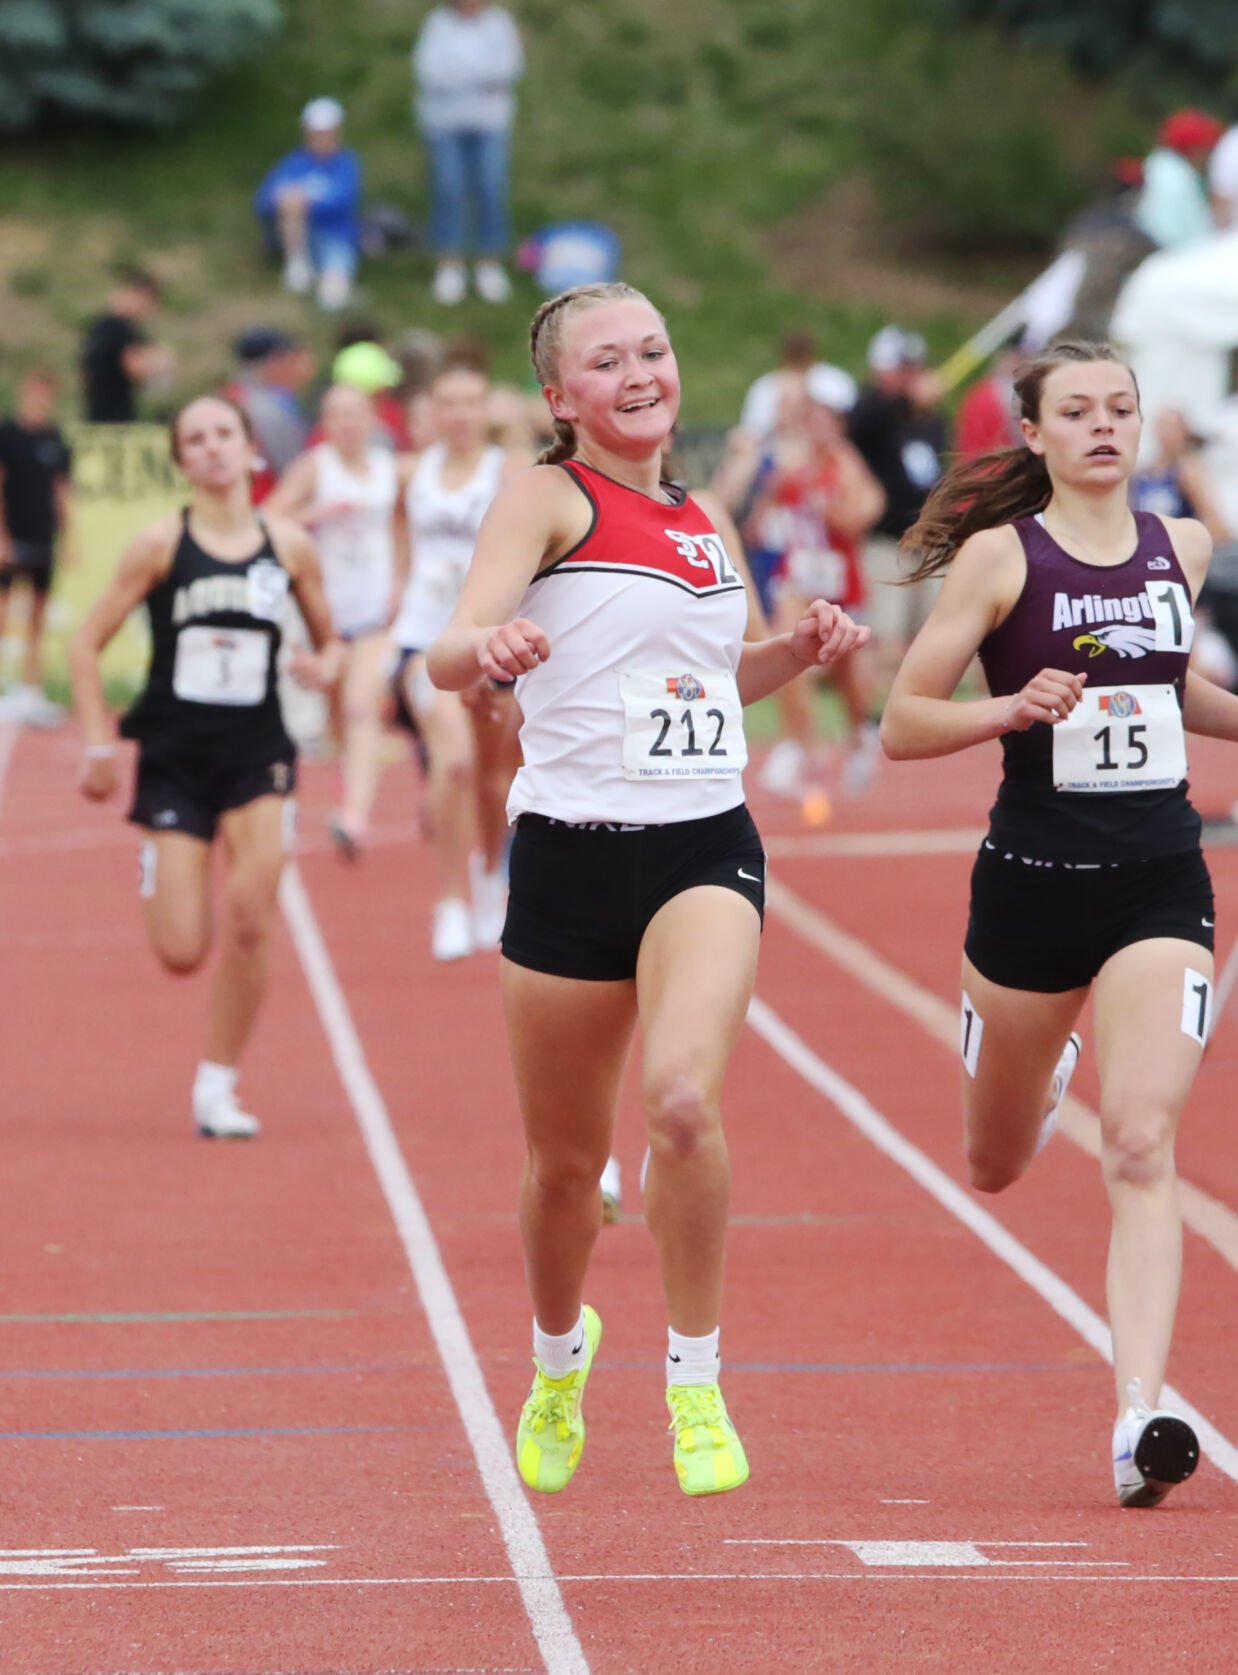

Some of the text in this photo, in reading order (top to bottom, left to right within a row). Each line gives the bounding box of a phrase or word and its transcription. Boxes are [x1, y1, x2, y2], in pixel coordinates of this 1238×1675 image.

[1156, 586, 1182, 647] 1
[648, 708, 728, 757] 212
[1093, 724, 1149, 771] 15
[638, 768, 662, 776] TRACK
[664, 768, 670, 776] &
[671, 768, 690, 776] FIELD
[1099, 780, 1119, 788] FIELD
[1121, 778, 1176, 788] CHAMPIONSHIPS
[963, 1008, 973, 1059] 1
[1192, 982, 1208, 1038] 1
